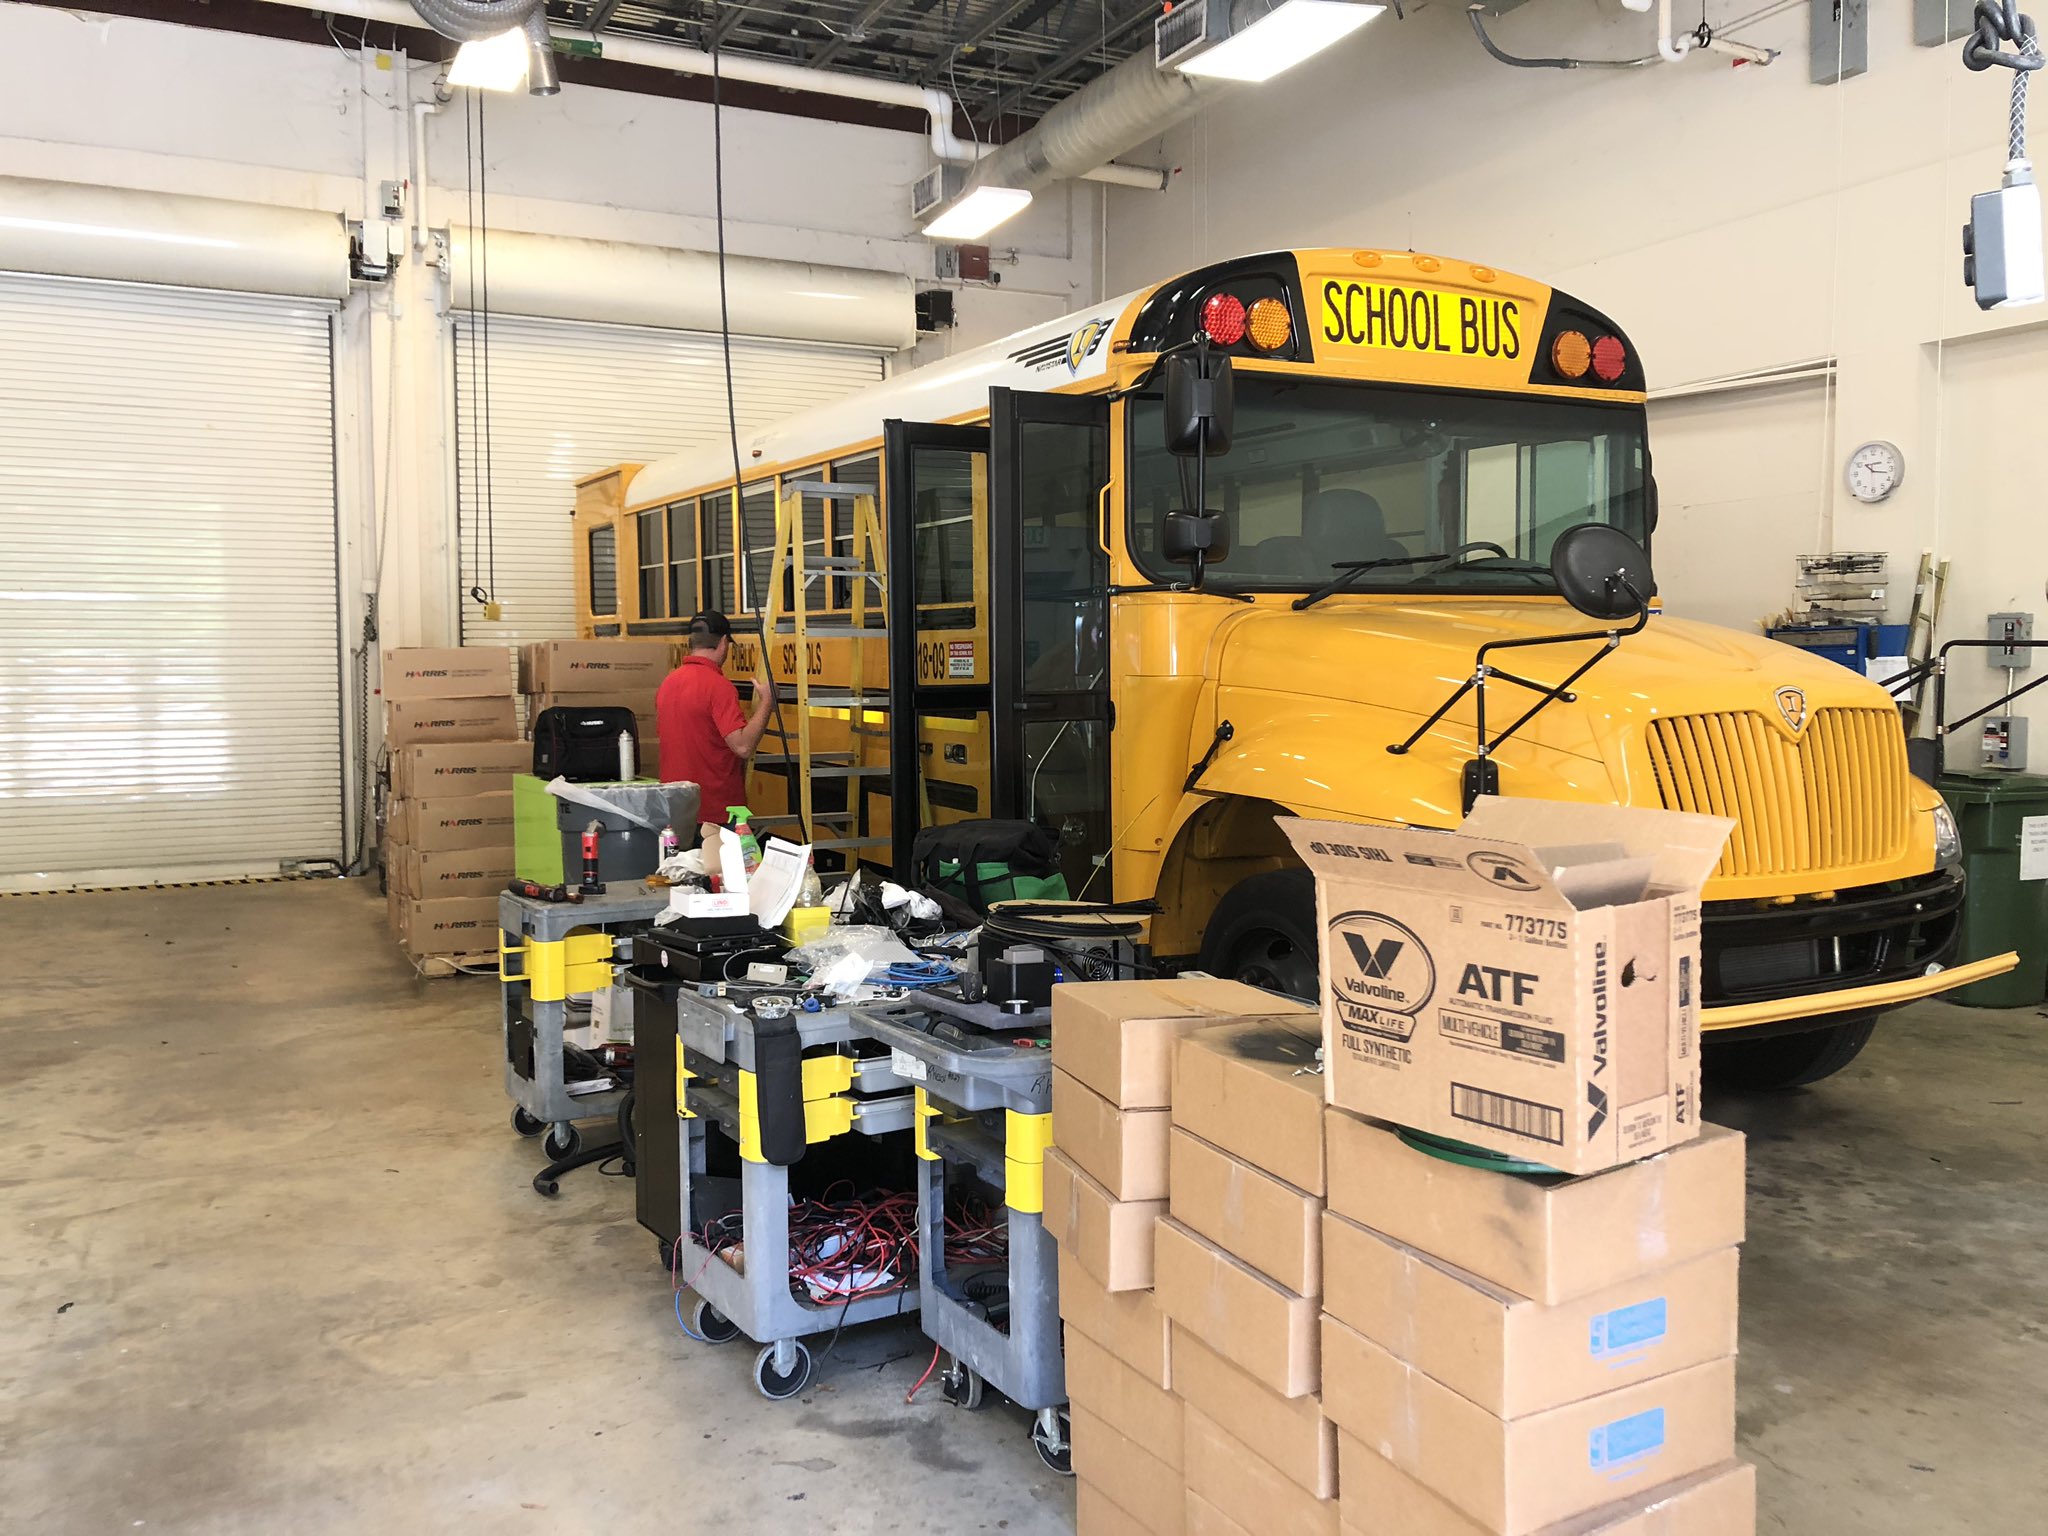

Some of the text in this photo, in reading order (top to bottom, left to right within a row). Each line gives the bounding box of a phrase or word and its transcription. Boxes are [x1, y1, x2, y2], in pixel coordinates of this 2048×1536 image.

[1324, 280, 1520, 360] SCHOOL BUS
[731, 643, 822, 675] PUBLIC SCHOLS
[918, 642, 945, 680] 18-09
[405, 670, 448, 678] HARRIS
[414, 720, 456, 728] HARRIS
[434, 767, 477, 775] HARRIS
[440, 818, 483, 827] HARRIS
[1310, 841, 1329, 855] UP
[1327, 843, 1360, 859] SIDE
[1358, 846, 1393, 863] THIS
[440, 871, 484, 880] HARRIS
[433, 921, 478, 930] HARRIS
[1504, 913, 1567, 939] 773775
[1344, 977, 1406, 1003] Valvoline
[1457, 963, 1539, 1006] ATF
[1348, 1005, 1406, 1030] MAX LIFE
[1593, 942, 1607, 1077] Valvoline
[1342, 1033, 1361, 1052] FULL
[1363, 1039, 1412, 1064] SYNTHETIC
[1675, 1083, 1685, 1124] ATF
